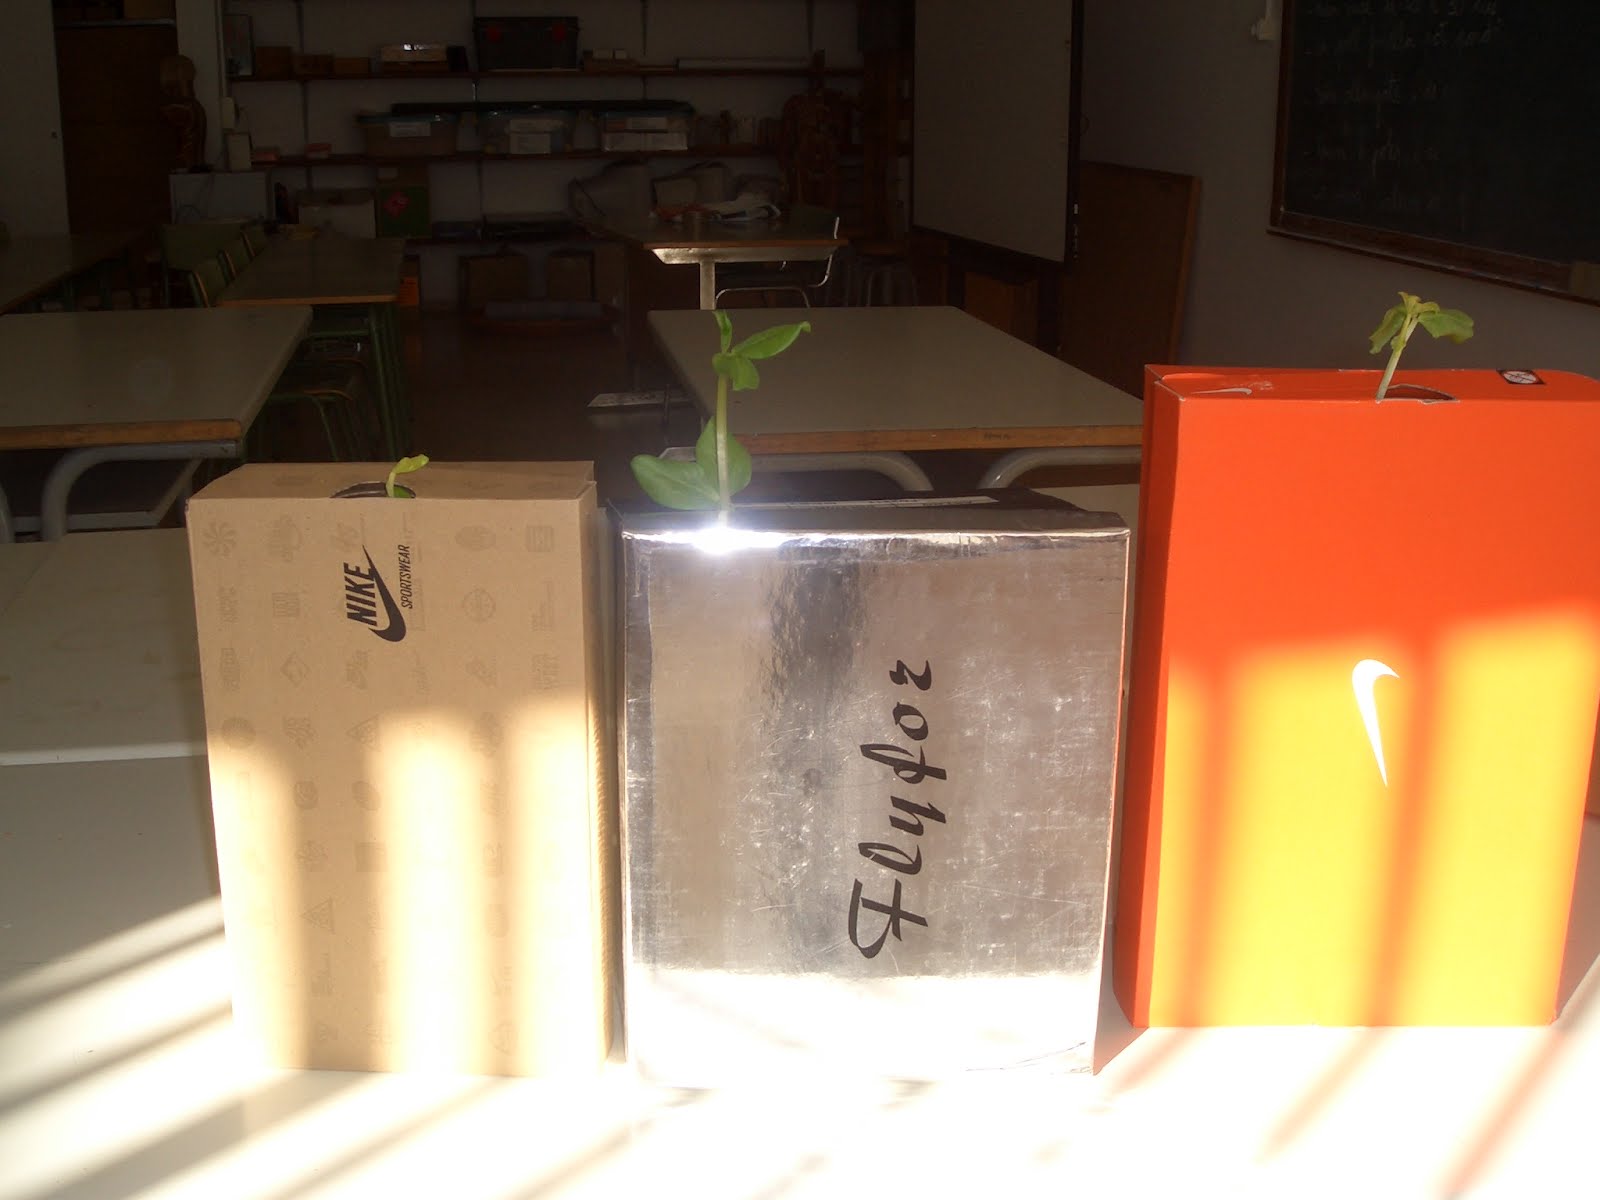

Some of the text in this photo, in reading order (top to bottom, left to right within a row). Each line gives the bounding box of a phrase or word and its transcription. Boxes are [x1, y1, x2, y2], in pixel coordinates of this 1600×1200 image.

[343, 562, 378, 627] NIKE
[397, 544, 413, 610] SPORTSWEAR
[848, 659, 947, 959] Flyfor
